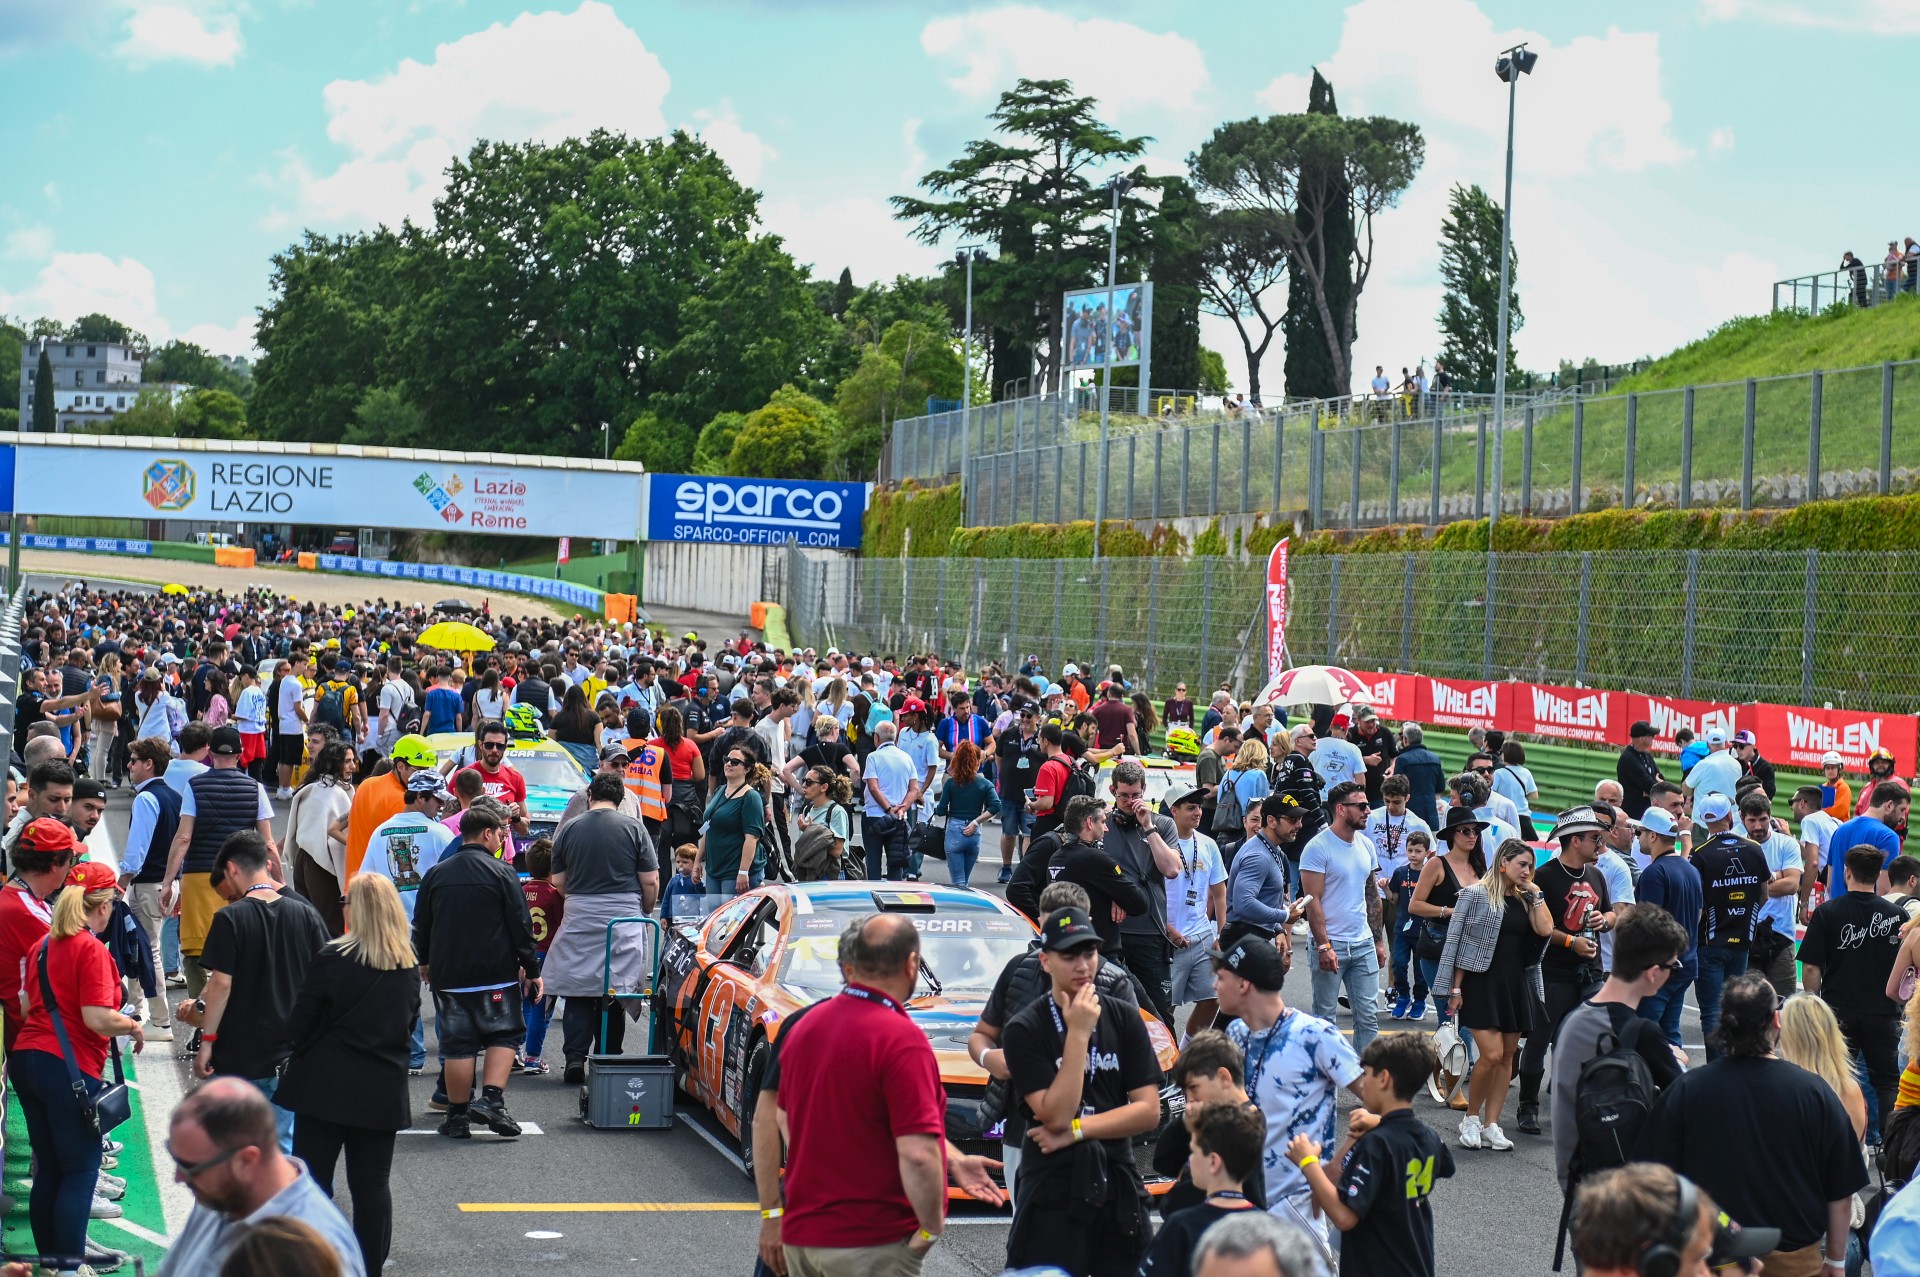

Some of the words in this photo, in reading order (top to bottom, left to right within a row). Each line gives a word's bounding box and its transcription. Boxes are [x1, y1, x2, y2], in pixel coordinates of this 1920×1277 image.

[211, 461, 333, 488] REGIONE
[474, 478, 526, 495] Lazio
[210, 490, 293, 513] LAZIO
[675, 481, 842, 524] sparco
[471, 511, 527, 528] Rome
[1430, 678, 1497, 717] WHELEN
[1531, 686, 1608, 728] WHELEN
[1433, 714, 1463, 725] ENGINEERING
[1535, 723, 1568, 737] ENGINEERING
[1568, 727, 1594, 740] COMPANY
[1594, 731, 1606, 742] INC.
[1786, 711, 1880, 755] WHELEN
[1712, 876, 1758, 888] ALUMITEC
[912, 920, 972, 932] SCAR
[1837, 923, 1868, 949] Dusty
[1869, 911, 1900, 938] Canyon
[629, 1113, 641, 1125] 11
[1406, 1155, 1434, 1199] 24
